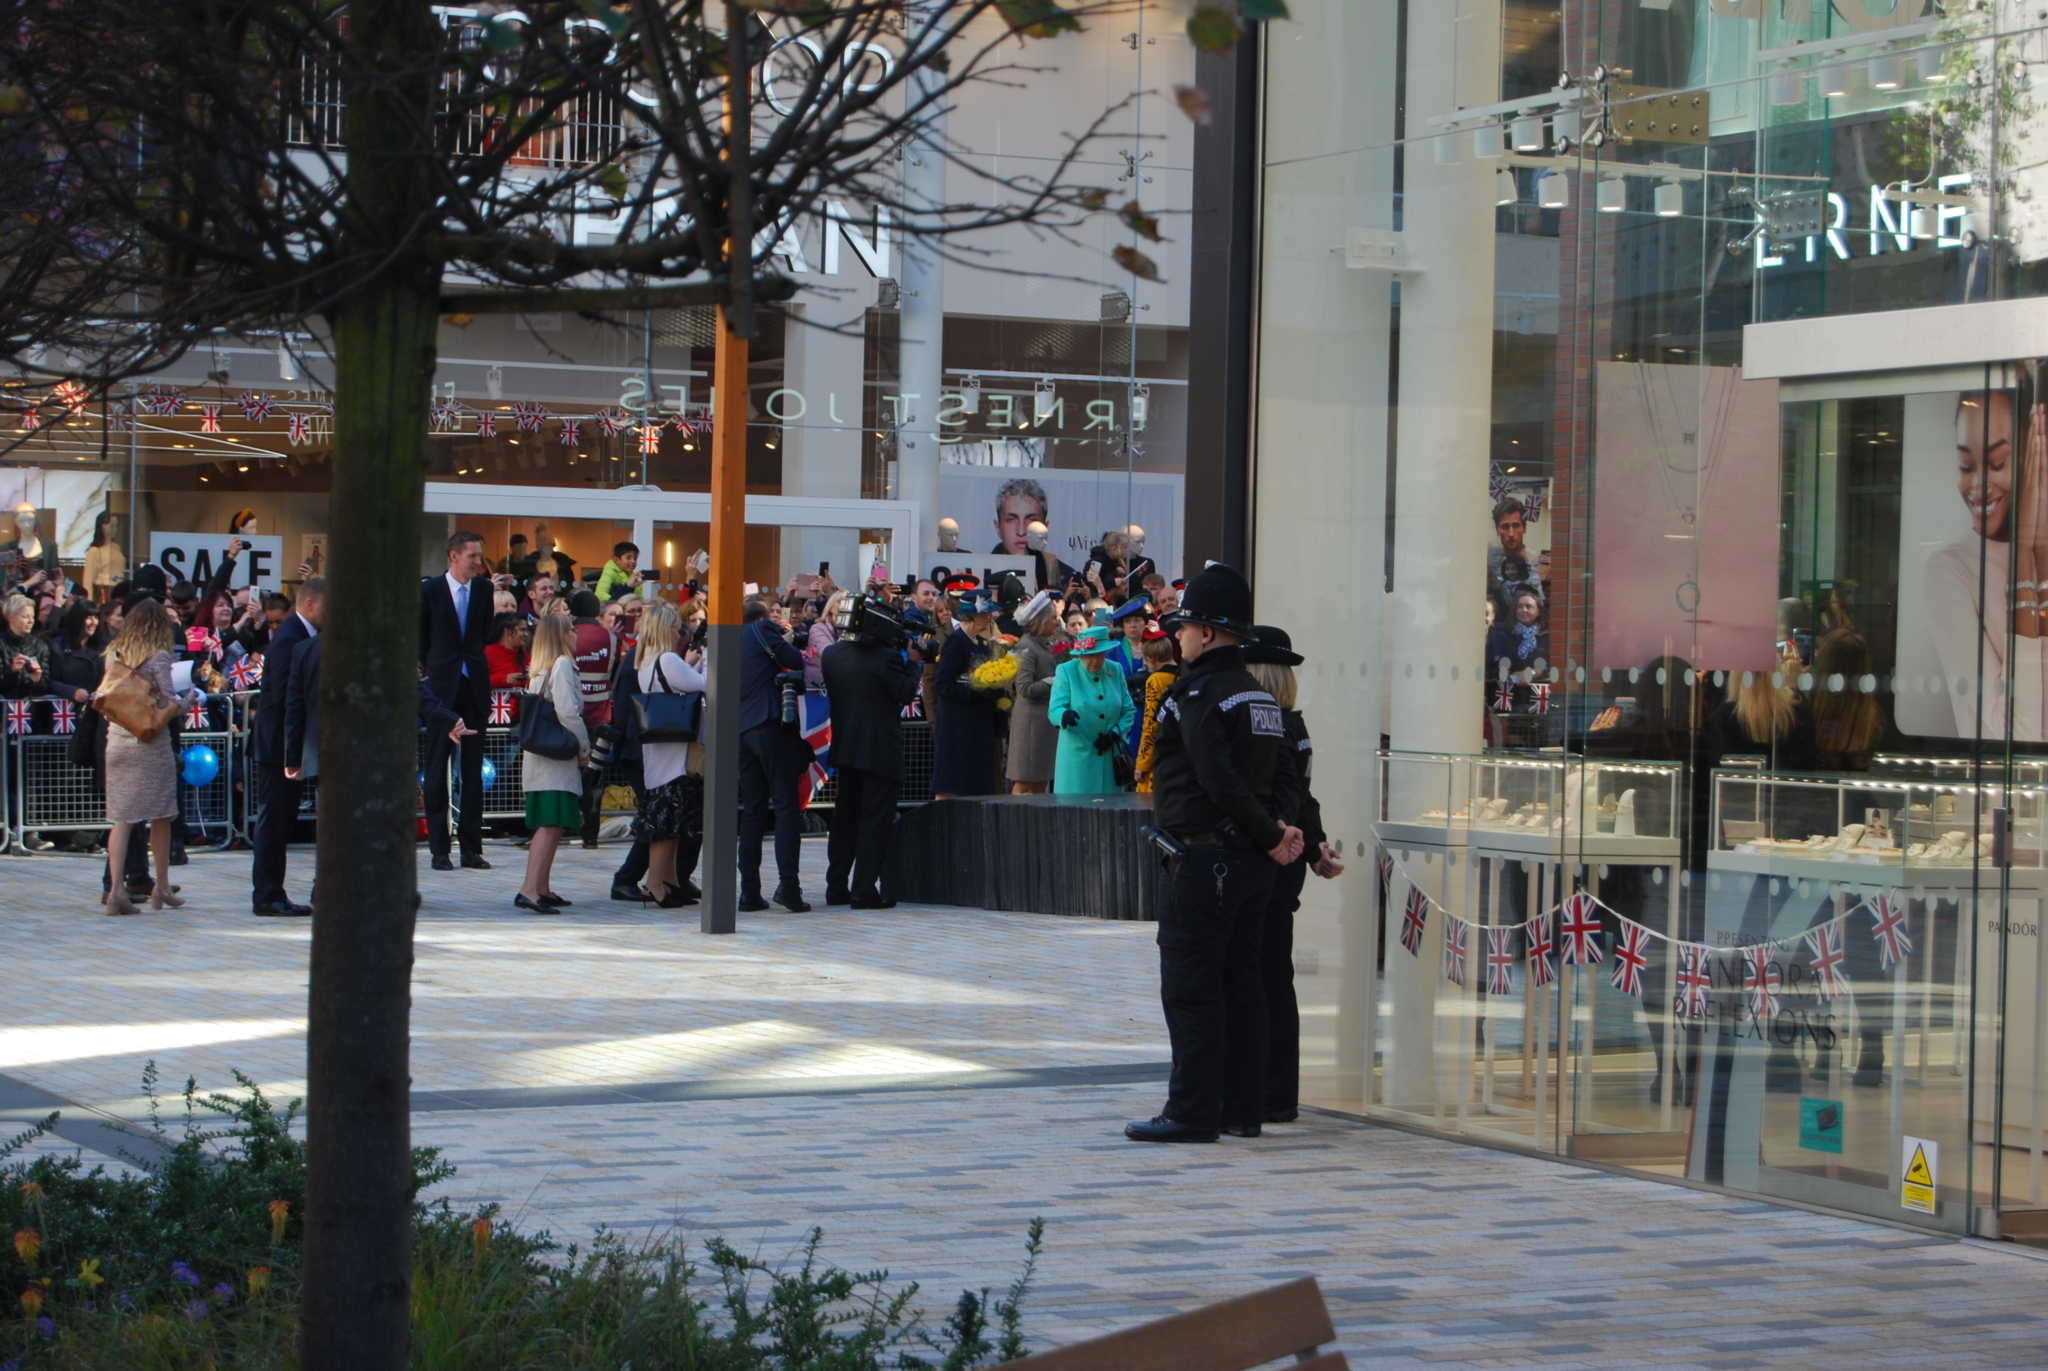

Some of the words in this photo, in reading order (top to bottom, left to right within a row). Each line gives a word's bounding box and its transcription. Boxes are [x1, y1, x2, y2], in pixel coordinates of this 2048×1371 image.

[430, 5, 894, 118] TOPOP
[593, 684, 607, 692] TEAM
[1252, 709, 1283, 732] POLICE
[1683, 952, 1825, 1002] PANDORA
[1672, 996, 1837, 1050] REFLEXIONS
